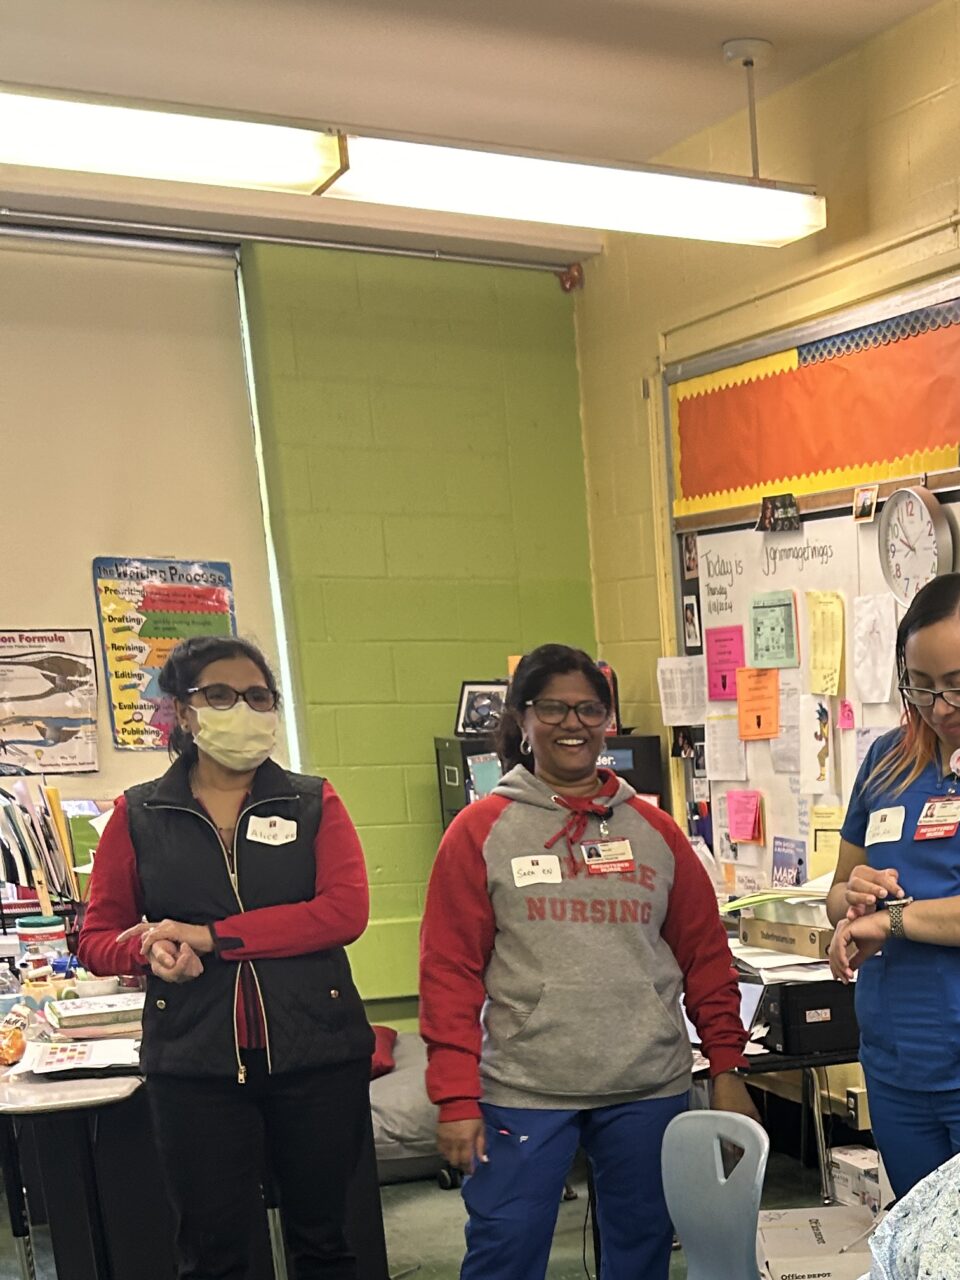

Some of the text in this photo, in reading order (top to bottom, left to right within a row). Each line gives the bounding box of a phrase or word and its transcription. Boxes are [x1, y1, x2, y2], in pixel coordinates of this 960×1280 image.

[905, 500, 914, 517] 12
[927, 520, 933, 537] 2
[890, 543, 896, 559] 9
[114, 562, 167, 581] Writing
[168, 566, 226, 585] Process
[700, 549, 744, 587] Today is
[895, 563, 901, 579] 8
[904, 577, 910, 593] 7
[19, 633, 66, 644] Formula
[773, 865, 798, 882] MARY
[525, 896, 653, 925] NURSING
[781, 1273, 806, 1280] Office
